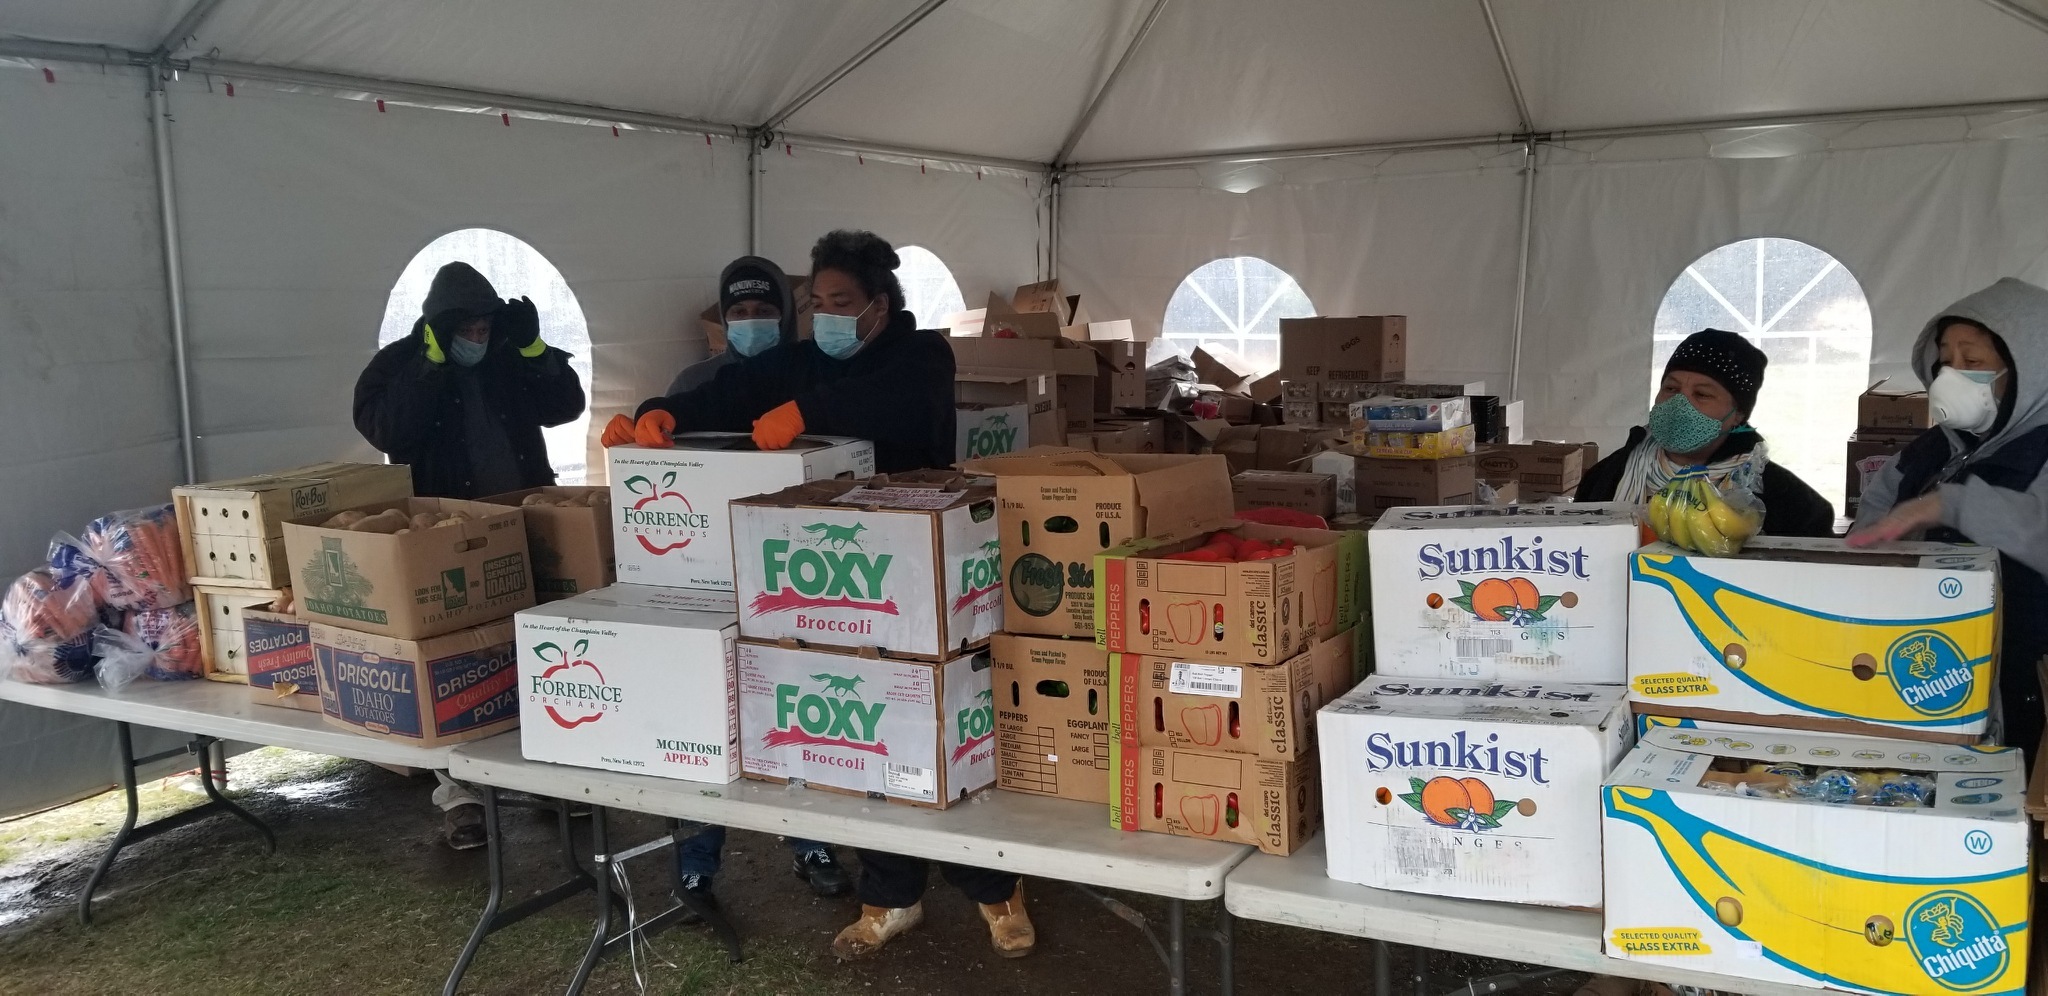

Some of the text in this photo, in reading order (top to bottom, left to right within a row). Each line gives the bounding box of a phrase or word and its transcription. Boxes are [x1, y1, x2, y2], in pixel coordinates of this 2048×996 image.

[1340, 336, 1360, 352] EGGS
[1306, 365, 1369, 380] KEEP REFRIGERATED
[966, 427, 1018, 458] FOXY
[622, 506, 709, 529] FORRENCE
[622, 526, 707, 538] ORCHARDS
[484, 558, 510, 571] INSIST
[1418, 535, 1590, 581] Sunkist
[485, 563, 523, 580] GENUINE
[762, 538, 894, 600] FOXY
[961, 552, 1001, 595] FOX
[414, 586, 429, 596] LOOK
[486, 571, 525, 598] IDAHO!
[1943, 582, 1959, 594] W
[468, 591, 525, 612] POTATOES
[972, 594, 1002, 616] Broccoli
[1065, 592, 1086, 600] PRODUCE
[336, 606, 387, 623] POTATOES
[1109, 583, 1120, 650] PEPPERS
[571, 627, 600, 635] Champlain
[601, 629, 618, 638] Valley
[796, 614, 872, 635] Broccoli
[1252, 600, 1268, 658] classic
[249, 630, 303, 653] POTATOES
[1097, 628, 1105, 646] bell
[258, 655, 280, 671] Fresh
[282, 646, 313, 664] Quality
[271, 664, 317, 683] RISCOLL
[338, 661, 411, 694] DRISCOLL
[437, 650, 517, 698] DRISCOLL
[1083, 669, 1108, 678] PRODUC
[1640, 675, 1708, 685] SELECTED QUALITY
[456, 678, 500, 709] Quality
[531, 675, 623, 703] FORRENCE
[1644, 684, 1709, 695] CLASS EXTRA
[1901, 665, 1974, 707] Chiquita
[351, 687, 393, 712] IDAHO
[473, 686, 519, 722] POTAT
[529, 695, 620, 712] ORCHARDS
[1124, 674, 1134, 741] PEPPERS
[354, 705, 396, 724] POTATOES
[776, 683, 887, 743] FOXY
[999, 711, 1028, 723] PEPPERS
[958, 701, 994, 744] FOX
[1006, 724, 1023, 732] LARGE
[1067, 719, 1108, 731] EGGPLANT
[1271, 696, 1287, 754] classic
[1070, 732, 1090, 741] FANCY
[1112, 722, 1121, 744] bell
[656, 738, 722, 756] MCINTOSH
[1000, 742, 1021, 750] MEDIUM
[1001, 751, 1017, 759] SMALL
[1071, 745, 1089, 753] LARGE
[663, 752, 709, 767] APPLES
[802, 749, 865, 771] Broccoli
[970, 747, 996, 766] Brocco
[1001, 760, 1018, 768] SELECT
[1072, 758, 1094, 767] CHOICE
[1365, 730, 1550, 787] Sunkist
[1013, 770, 1024, 778] TAN
[1125, 758, 1135, 825] PEPPERS
[1112, 805, 1121, 823] bell
[1266, 790, 1281, 848] classic
[1971, 836, 1987, 849] W
[1620, 932, 1698, 941] SELECTED QUALITY
[1625, 941, 1700, 952] CLASS EXTRA
[1922, 931, 2008, 979] Chiquita
